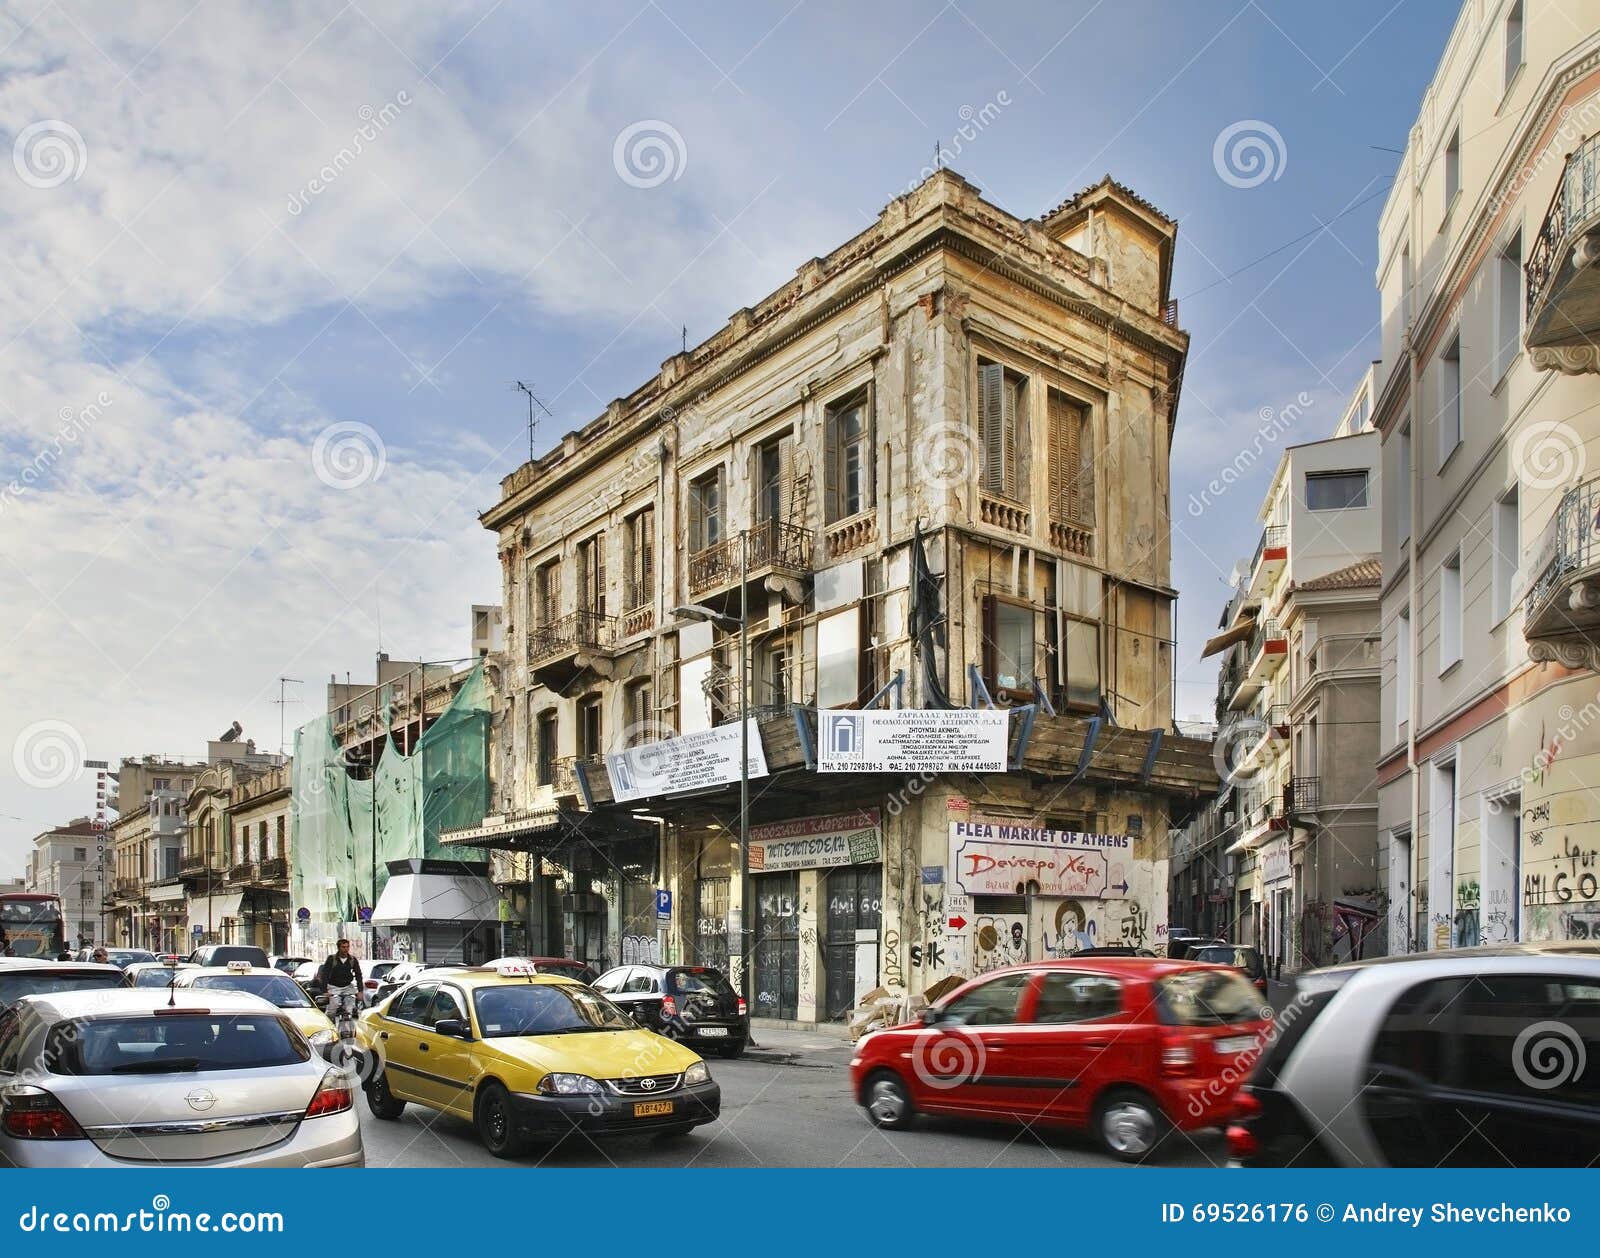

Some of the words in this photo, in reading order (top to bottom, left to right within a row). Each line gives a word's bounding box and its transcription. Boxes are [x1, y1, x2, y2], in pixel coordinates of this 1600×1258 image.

[837, 762, 849, 771] 210
[904, 762, 916, 771] 210
[961, 762, 974, 771] 694
[96, 772, 105, 819] PELLA
[956, 822, 993, 838] FLEA
[999, 825, 1057, 843] MARKET
[1061, 830, 1078, 844] OF
[1082, 833, 1129, 848] ATHENS
[661, 893, 669, 907] P
